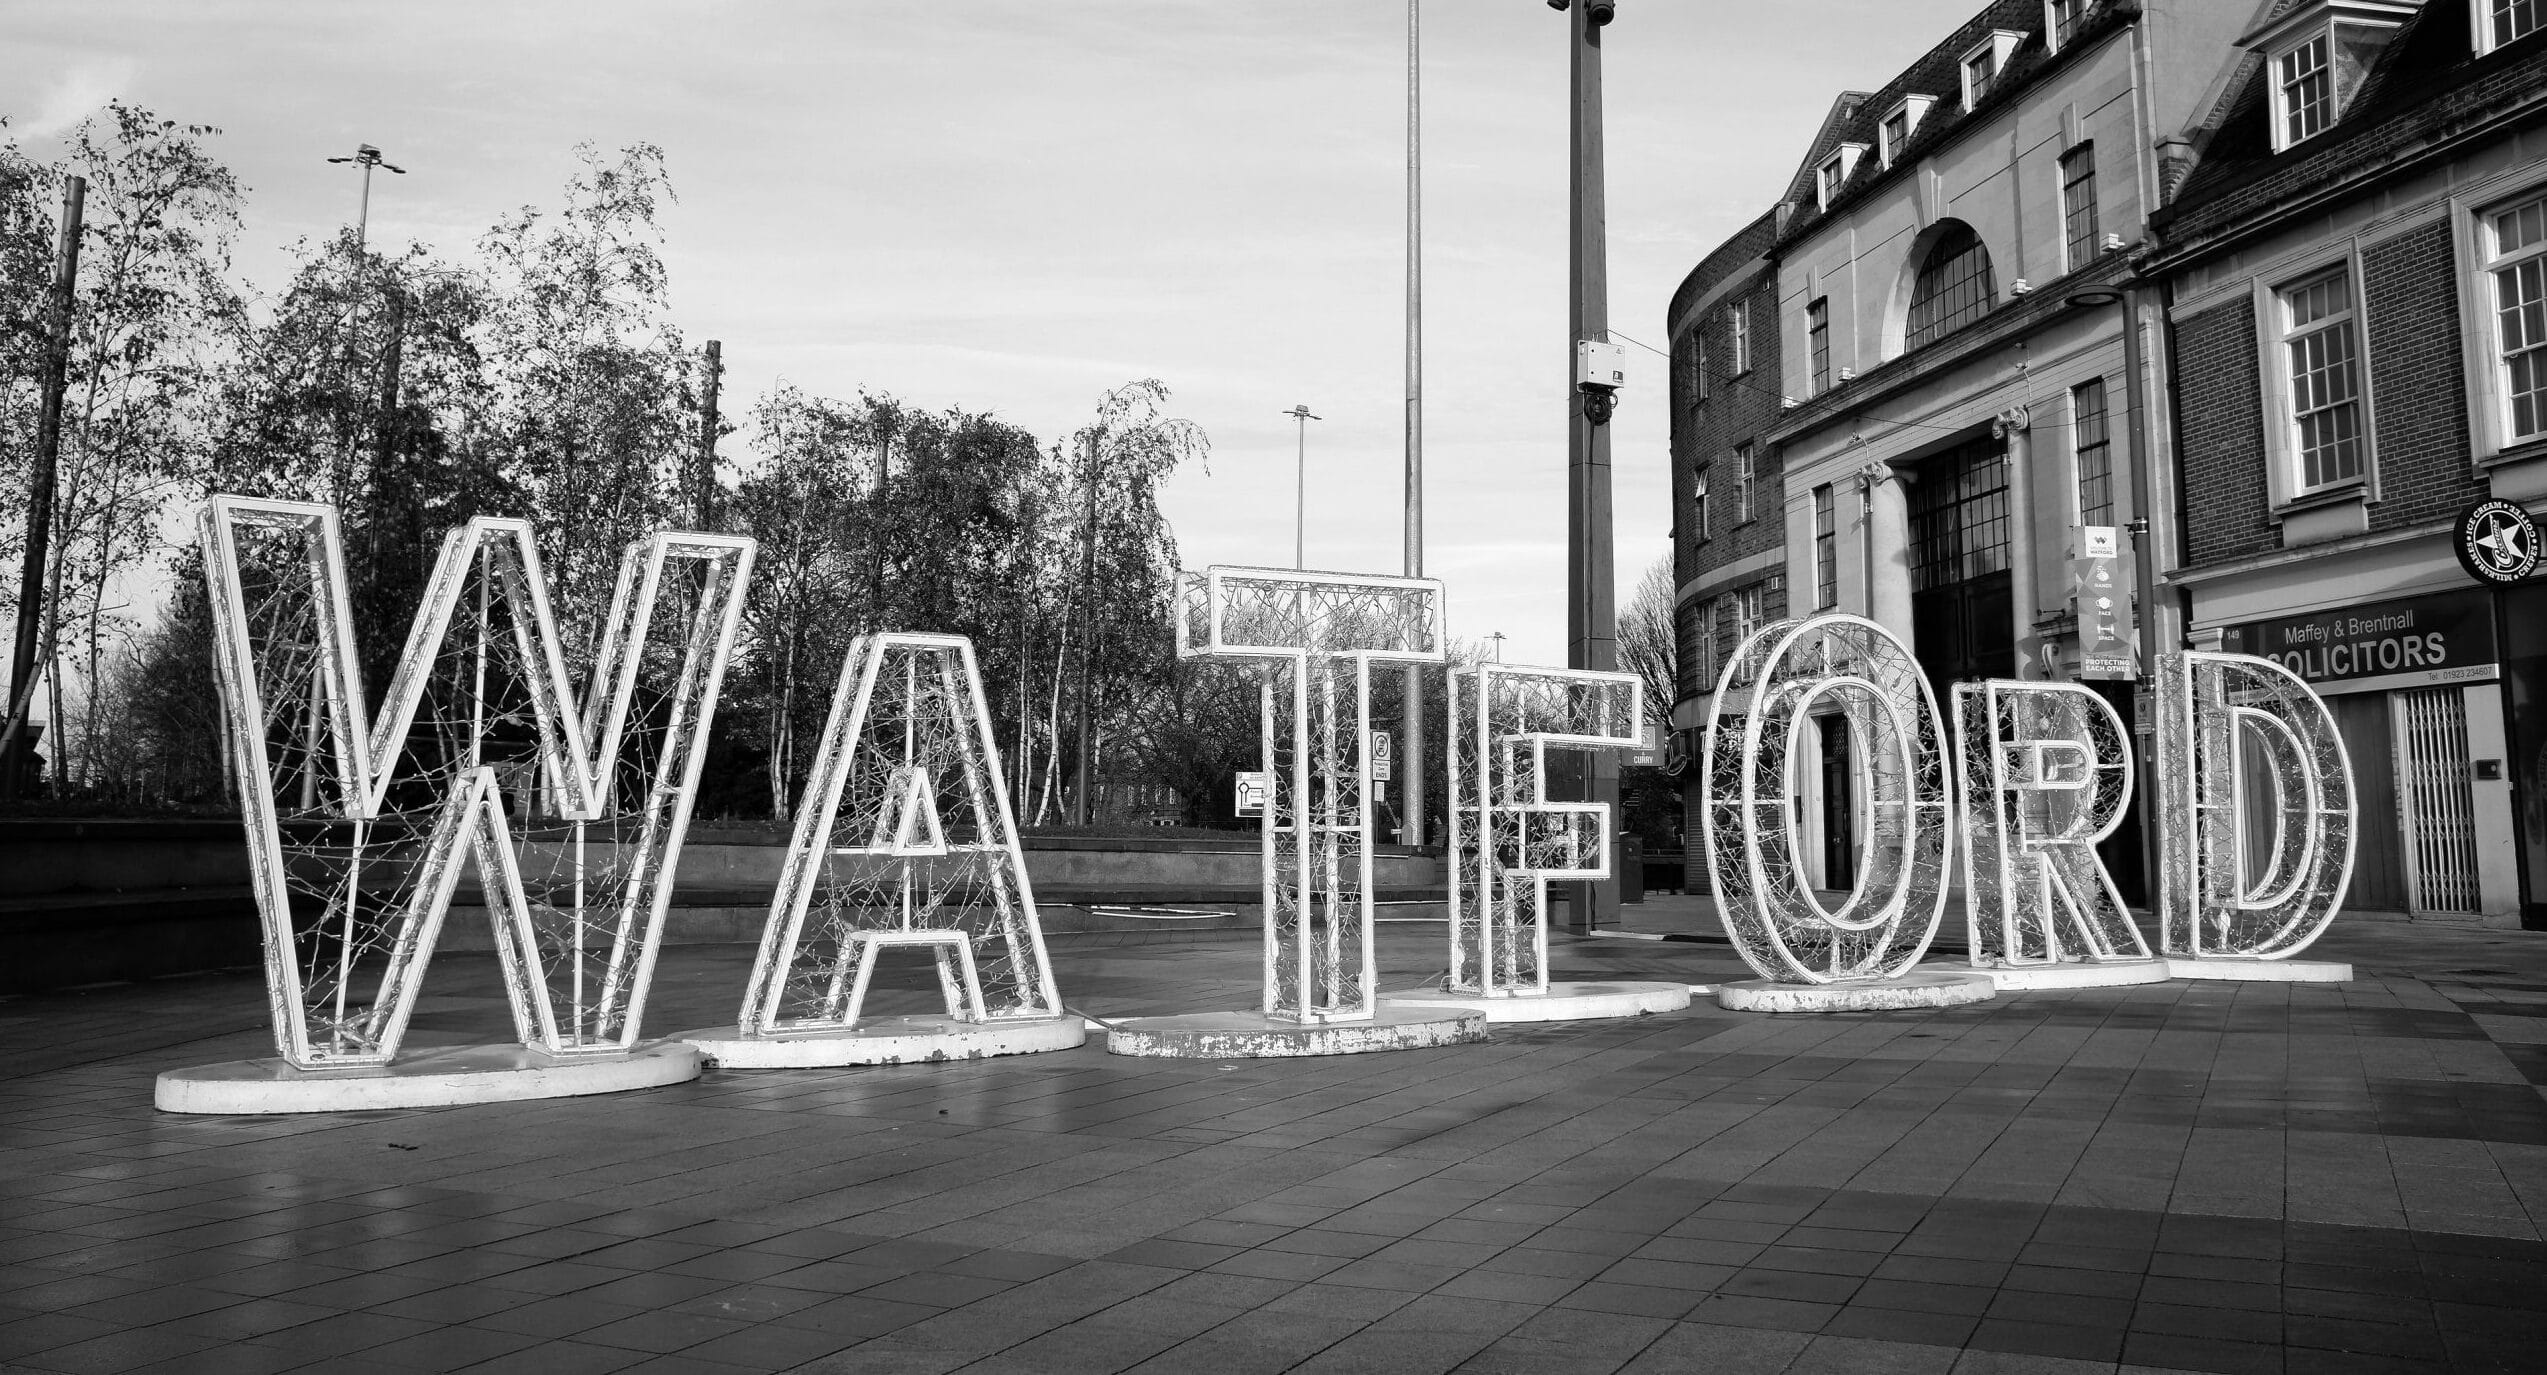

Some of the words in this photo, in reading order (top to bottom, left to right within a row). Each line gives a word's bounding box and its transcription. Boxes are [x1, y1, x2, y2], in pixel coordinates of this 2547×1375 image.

[2466, 517, 2476, 535] ICE
[2473, 501, 2502, 519] CREAM
[2508, 505, 2536, 538] COFFEE
[2466, 542, 2513, 582] MILKSHAKES
[2518, 545, 2538, 577] CREPES
[2227, 629, 2240, 641] 149
[2285, 623, 2330, 644] Maffey
[2334, 620, 2345, 638] &
[2349, 608, 2414, 636] Brentnall
[1633, 755, 1654, 764] CURRY
[199, 494, 2358, 1070] WATFORD
